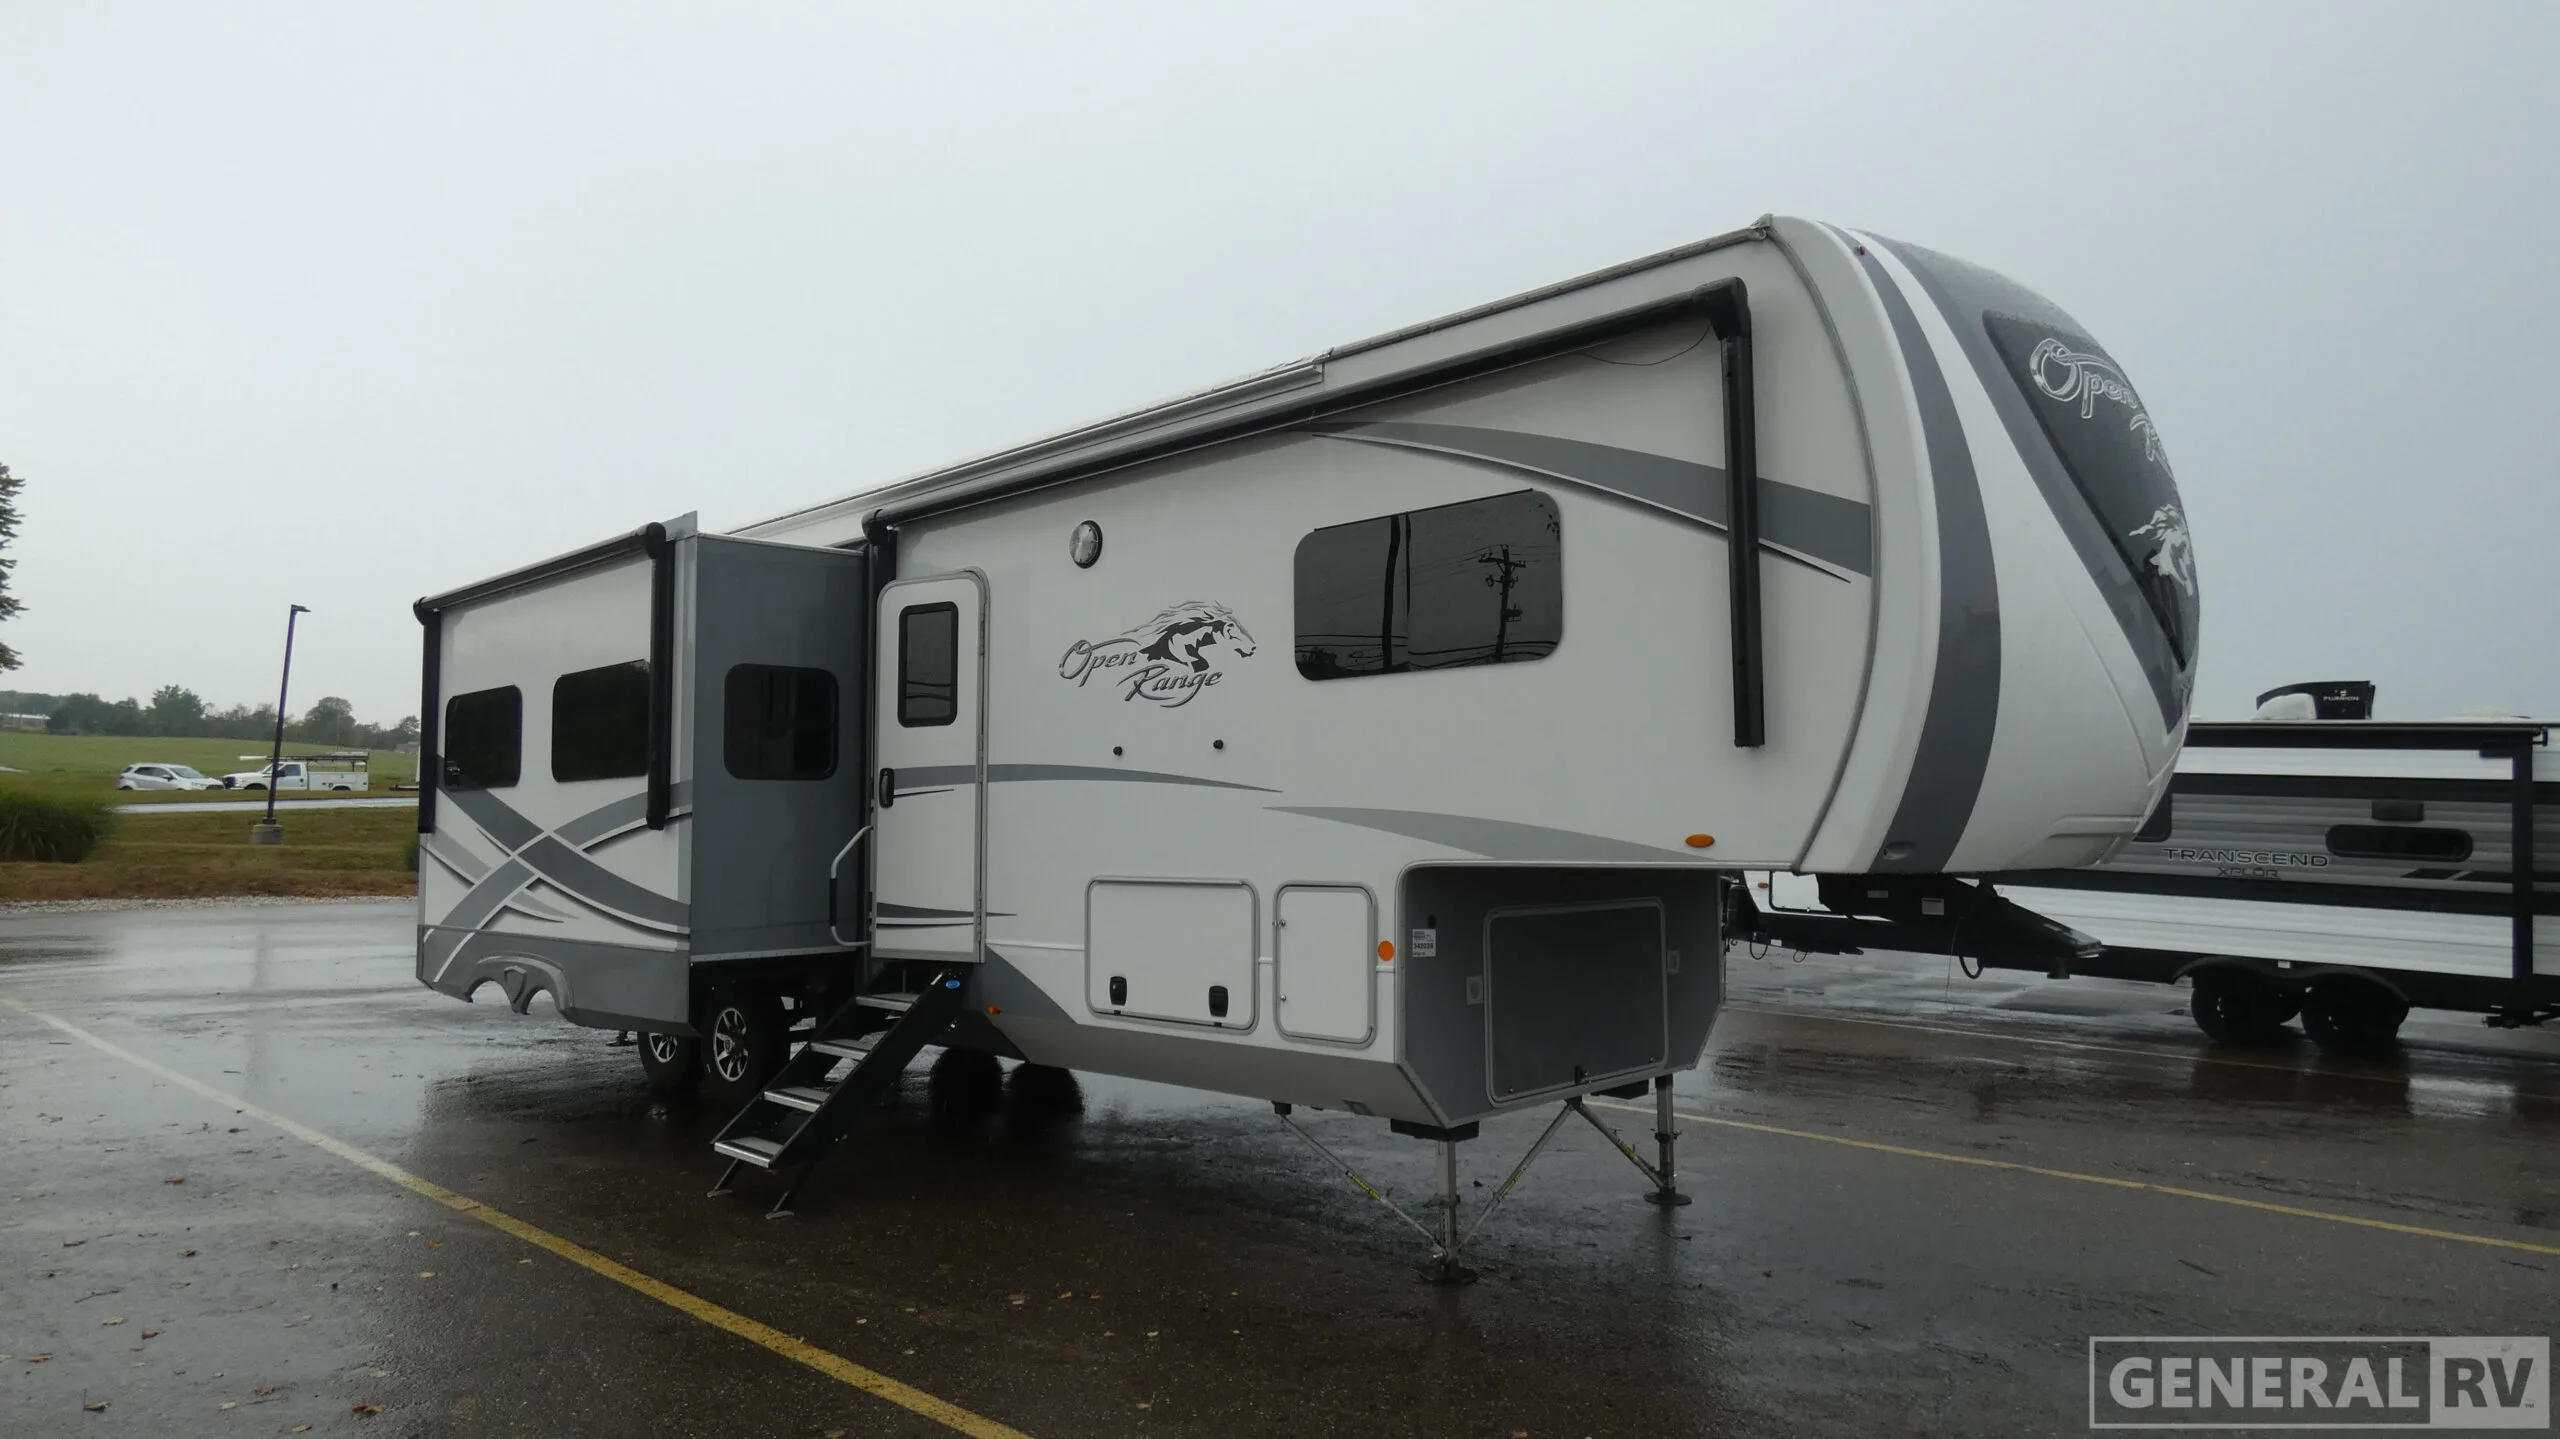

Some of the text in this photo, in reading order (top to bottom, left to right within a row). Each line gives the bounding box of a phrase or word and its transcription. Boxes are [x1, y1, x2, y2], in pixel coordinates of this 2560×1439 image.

[2029, 338, 2139, 419] Open
[1058, 639, 1141, 688] Open
[1116, 664, 1223, 708] Range
[2163, 847, 2330, 868] TRANSCEND
